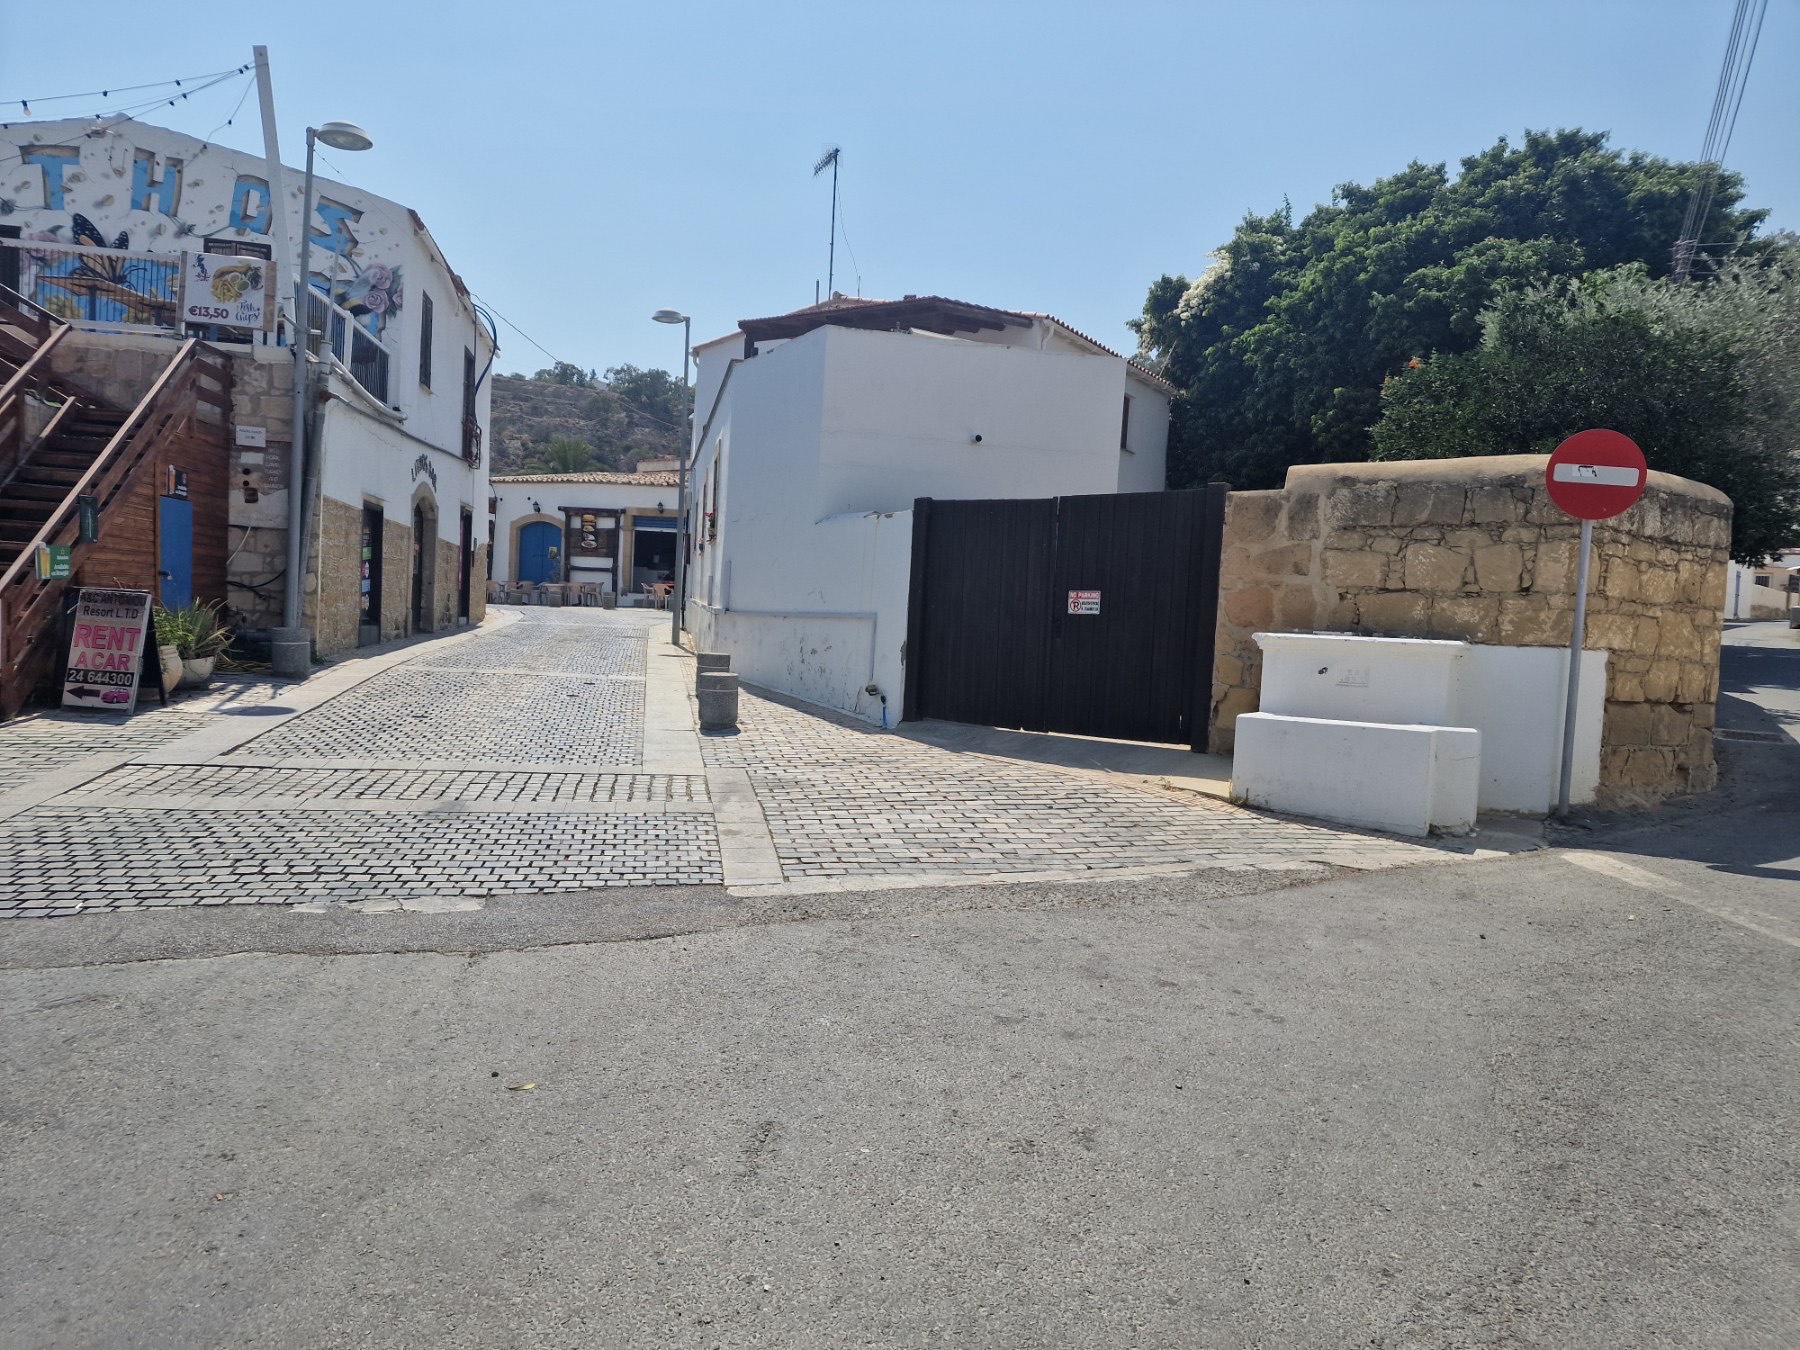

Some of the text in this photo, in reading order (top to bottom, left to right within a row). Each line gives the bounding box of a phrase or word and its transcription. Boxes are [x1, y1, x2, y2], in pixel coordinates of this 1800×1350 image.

[188, 305, 230, 319] €13,50
[83, 605, 114, 617] Resort
[73, 624, 142, 652] RENT
[75, 651, 131, 671] A CAR
[68, 670, 132, 686] 24 644300
